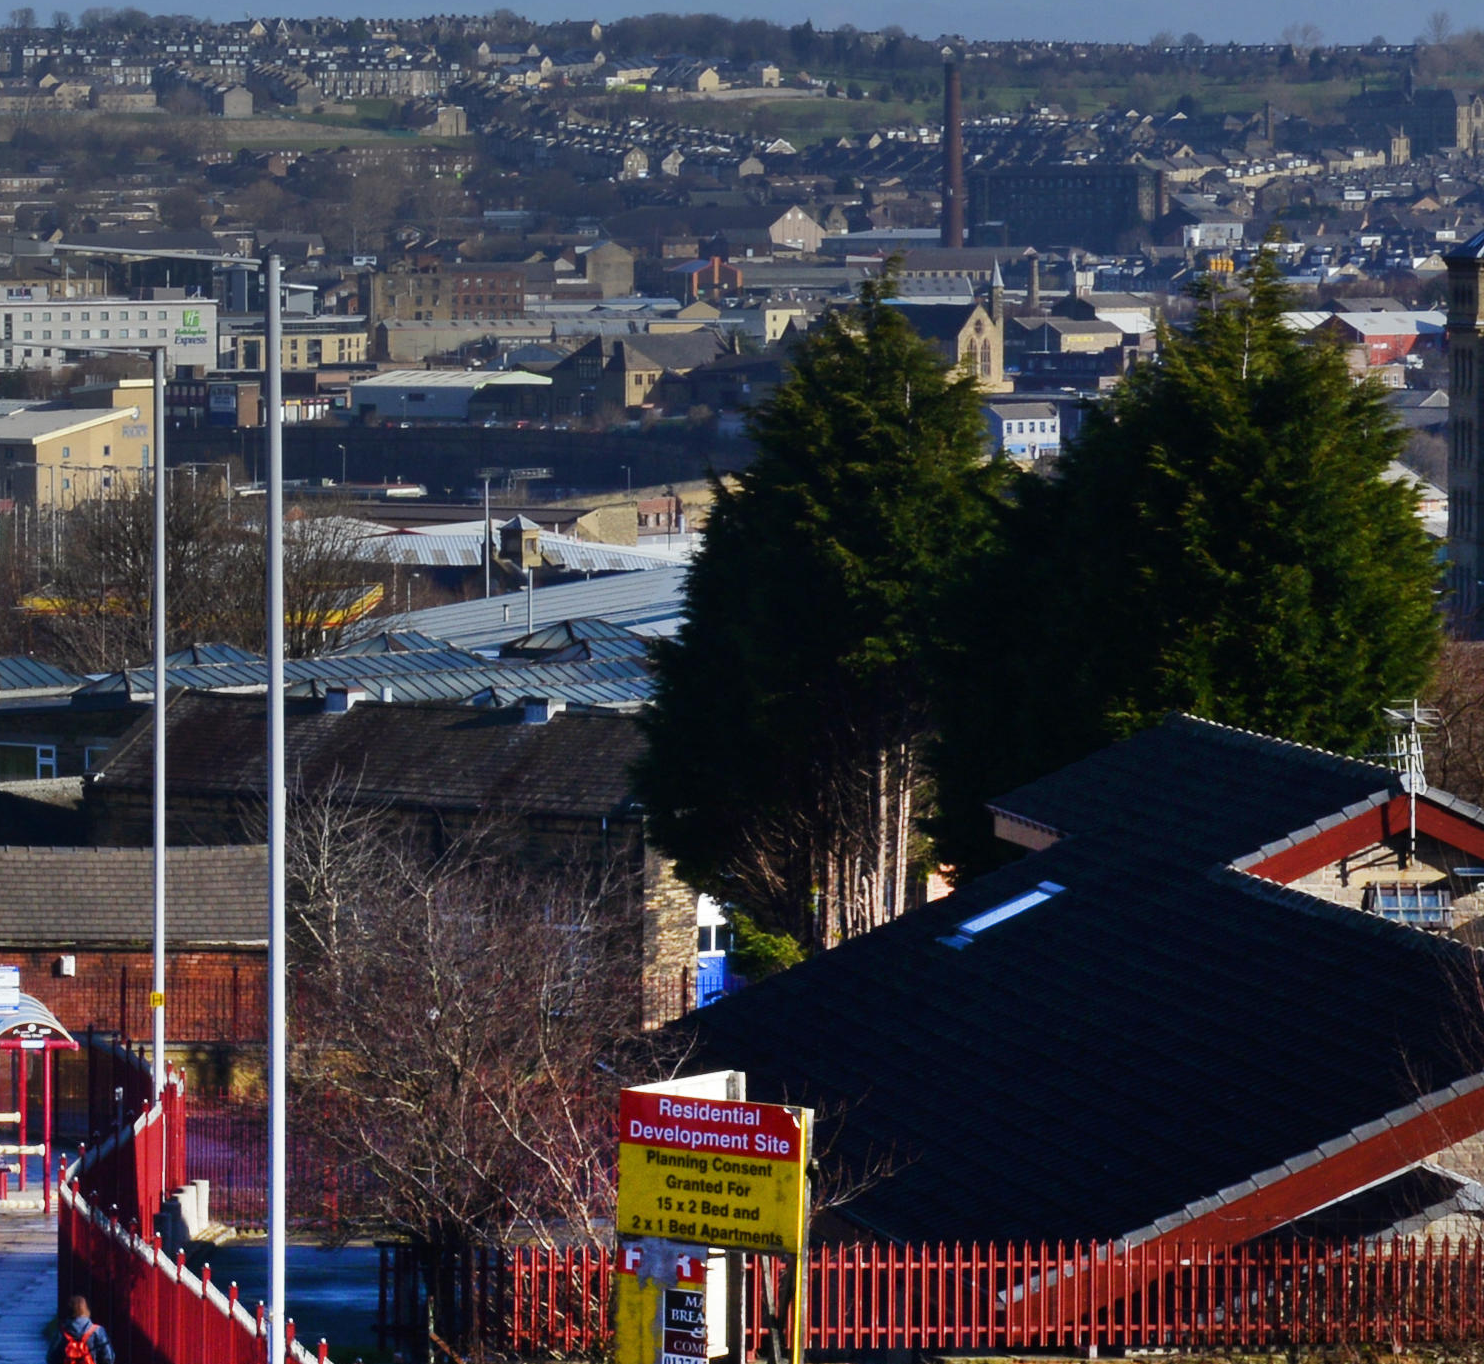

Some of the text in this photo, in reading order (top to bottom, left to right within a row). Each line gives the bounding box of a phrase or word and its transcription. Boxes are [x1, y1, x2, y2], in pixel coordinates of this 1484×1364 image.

[175, 336, 208, 346] Express
[659, 1098, 761, 1126] Residential
[630, 1120, 790, 1154] Development Site
[646, 1149, 772, 1177] Planning Consent
[665, 1175, 752, 1197] Granted For
[656, 1197, 760, 1221] 15 x 2 Bed and
[632, 1215, 784, 1246] 2 x 1 Bed Apartments
[671, 1308, 705, 1324] BREA
